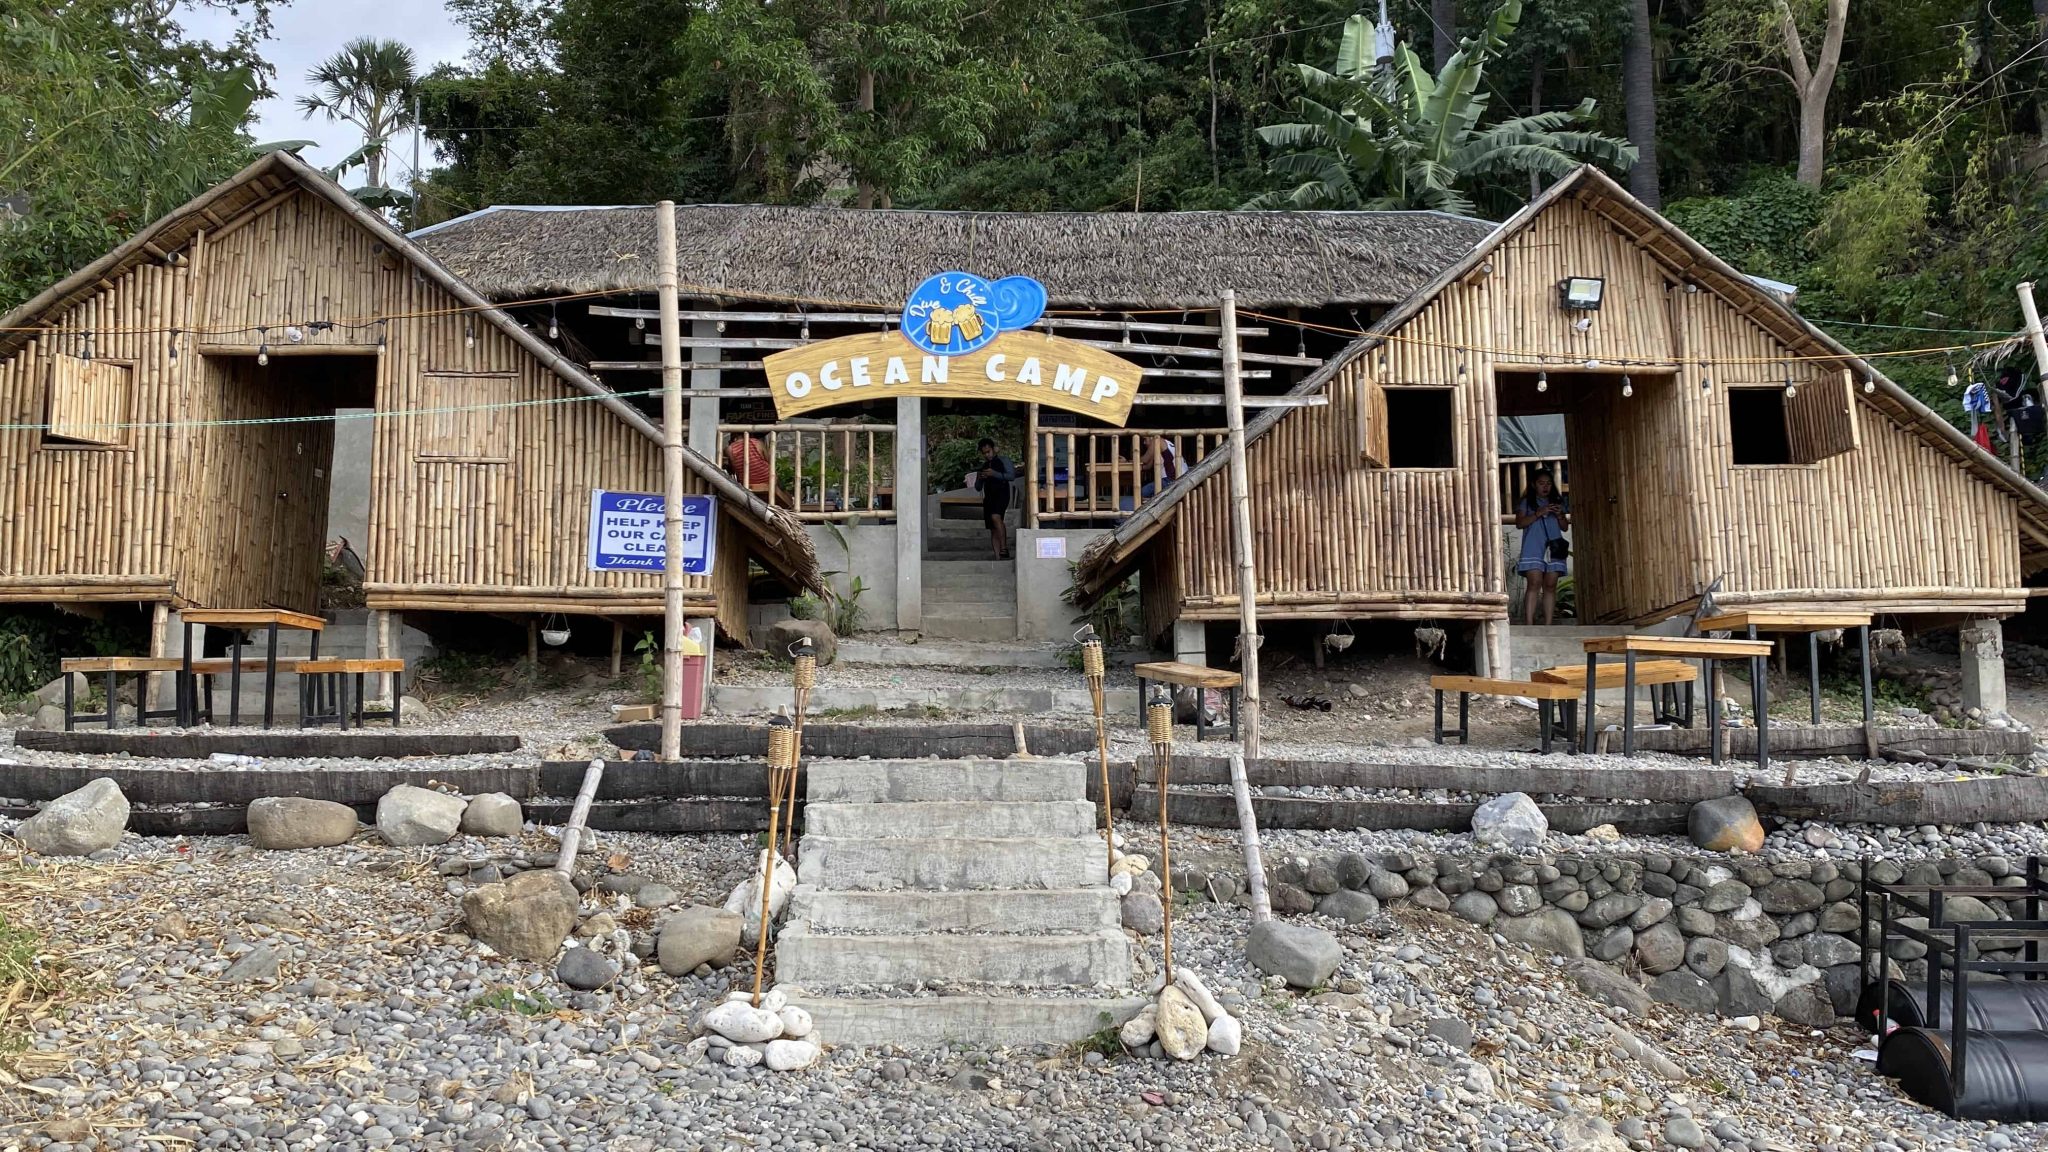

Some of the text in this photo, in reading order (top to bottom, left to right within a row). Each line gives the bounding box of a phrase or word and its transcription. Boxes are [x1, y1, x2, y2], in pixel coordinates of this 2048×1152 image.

[909, 277, 987, 318] Dive & Chill
[785, 354, 1120, 404] OCEAN CAMP
[606, 517, 701, 530] HELP KEP
[607, 530, 644, 540] OUR
[623, 543, 667, 552] CLEA
[605, 556, 654, 566] Thank
